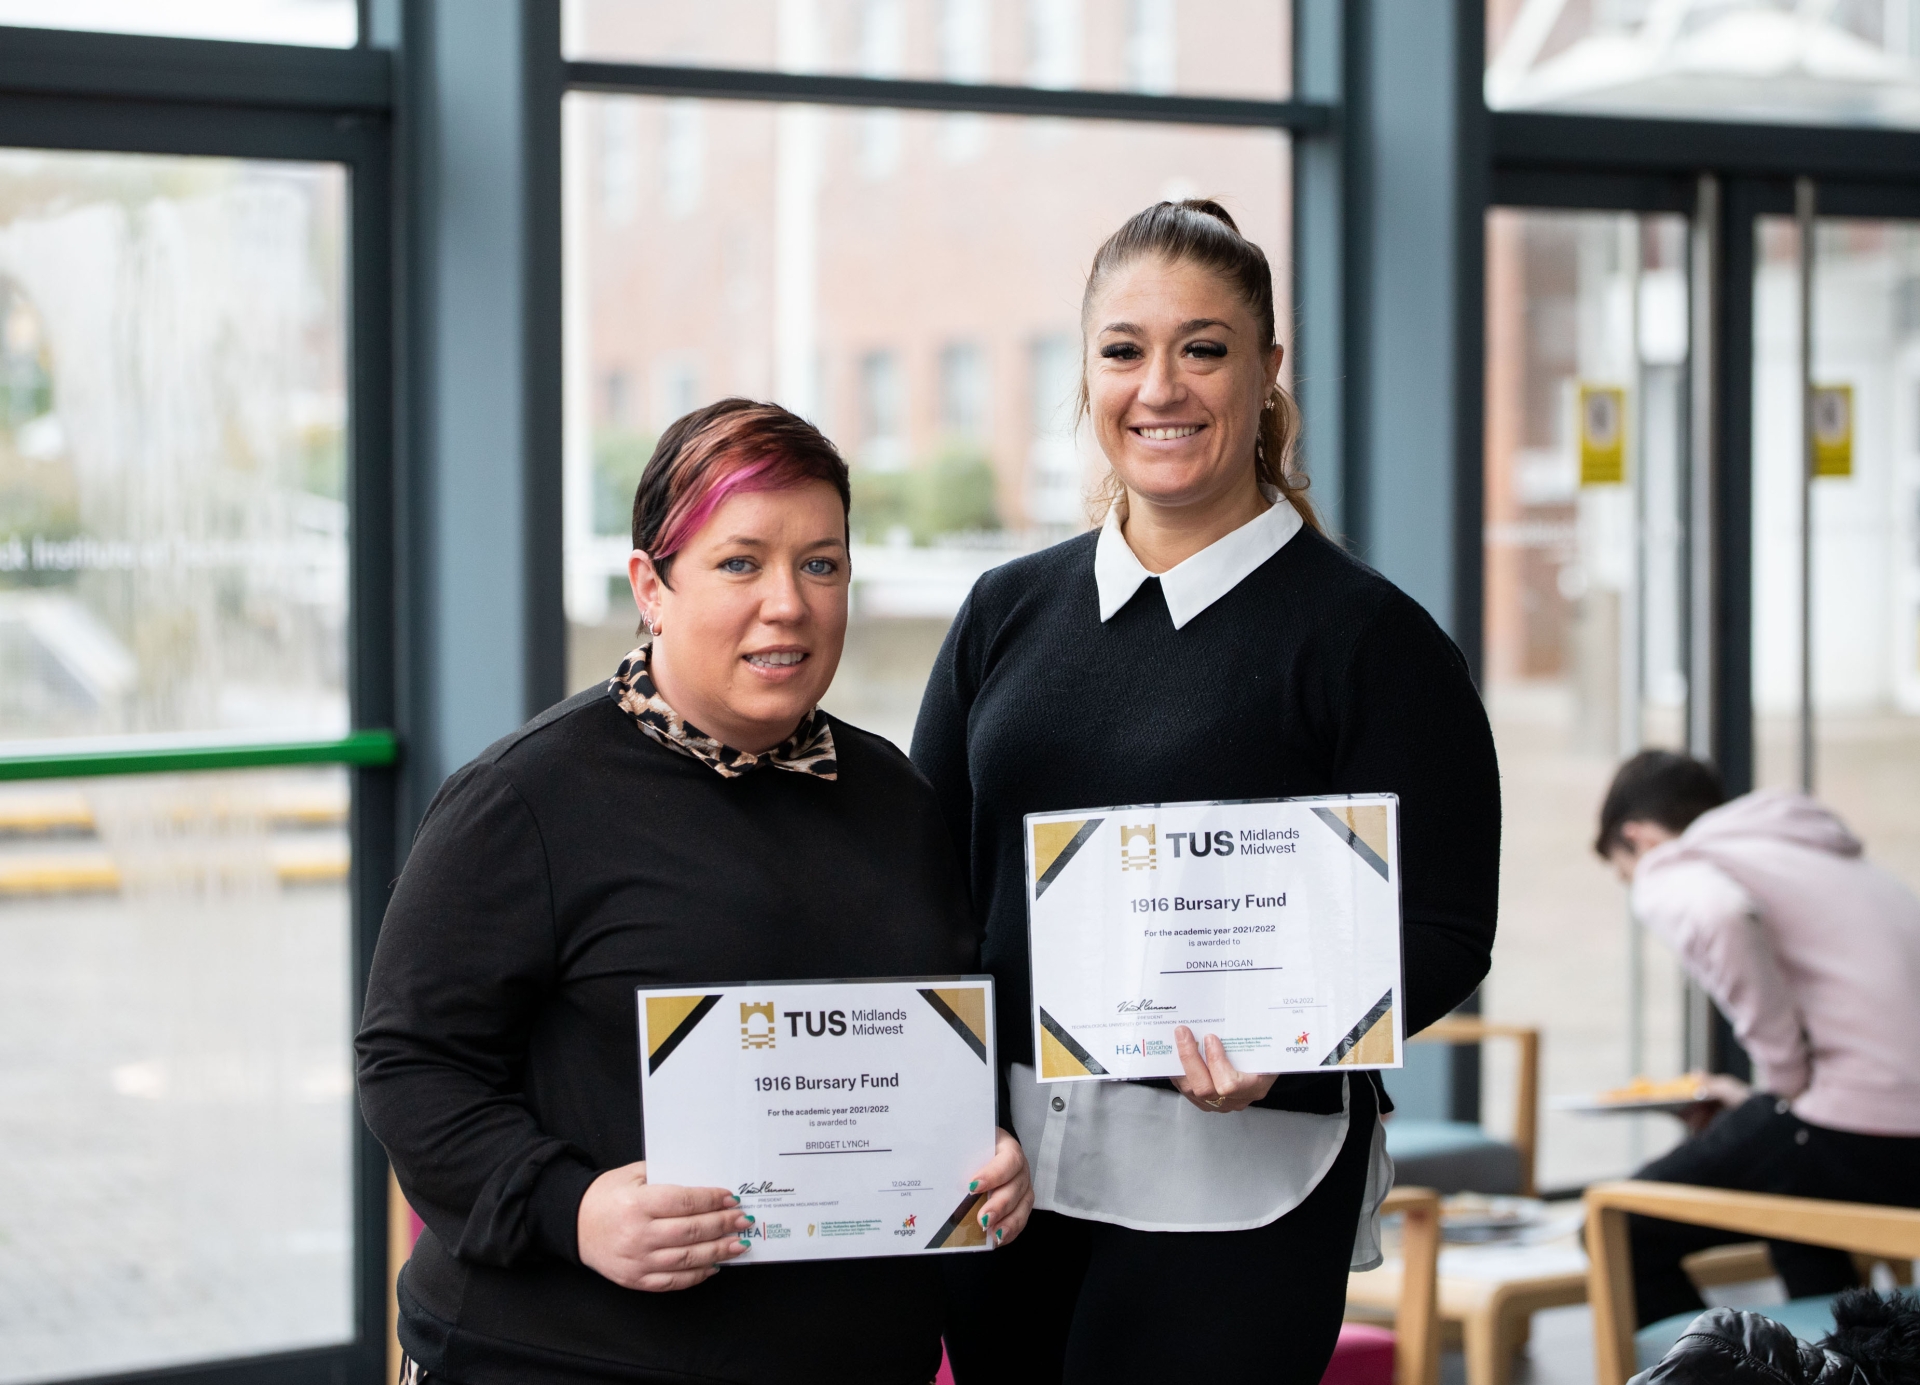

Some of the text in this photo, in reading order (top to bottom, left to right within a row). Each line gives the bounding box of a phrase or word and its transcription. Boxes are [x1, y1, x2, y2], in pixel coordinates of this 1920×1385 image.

[1240, 828, 1300, 841] Midlands
[1166, 831, 1235, 858] TUS
[1240, 842, 1296, 855] Midwest
[1131, 892, 1287, 912] 1916 Bursary Fund
[1174, 928, 1212, 936] academic
[1213, 928, 1231, 936] year
[1233, 925, 1276, 933] 2021/2022
[1186, 960, 1253, 969] DONNA HOGAN
[852, 1009, 906, 1021] Midlands
[784, 1010, 846, 1037] TUS
[852, 1023, 903, 1035] Midwest
[1116, 1044, 1141, 1055] HEA
[1286, 1045, 1309, 1053] engage
[755, 1073, 899, 1092] 1916 Bursary Fund
[850, 1106, 889, 1114] 2021/2022
[806, 1140, 869, 1149] BRIDGET LYNCH
